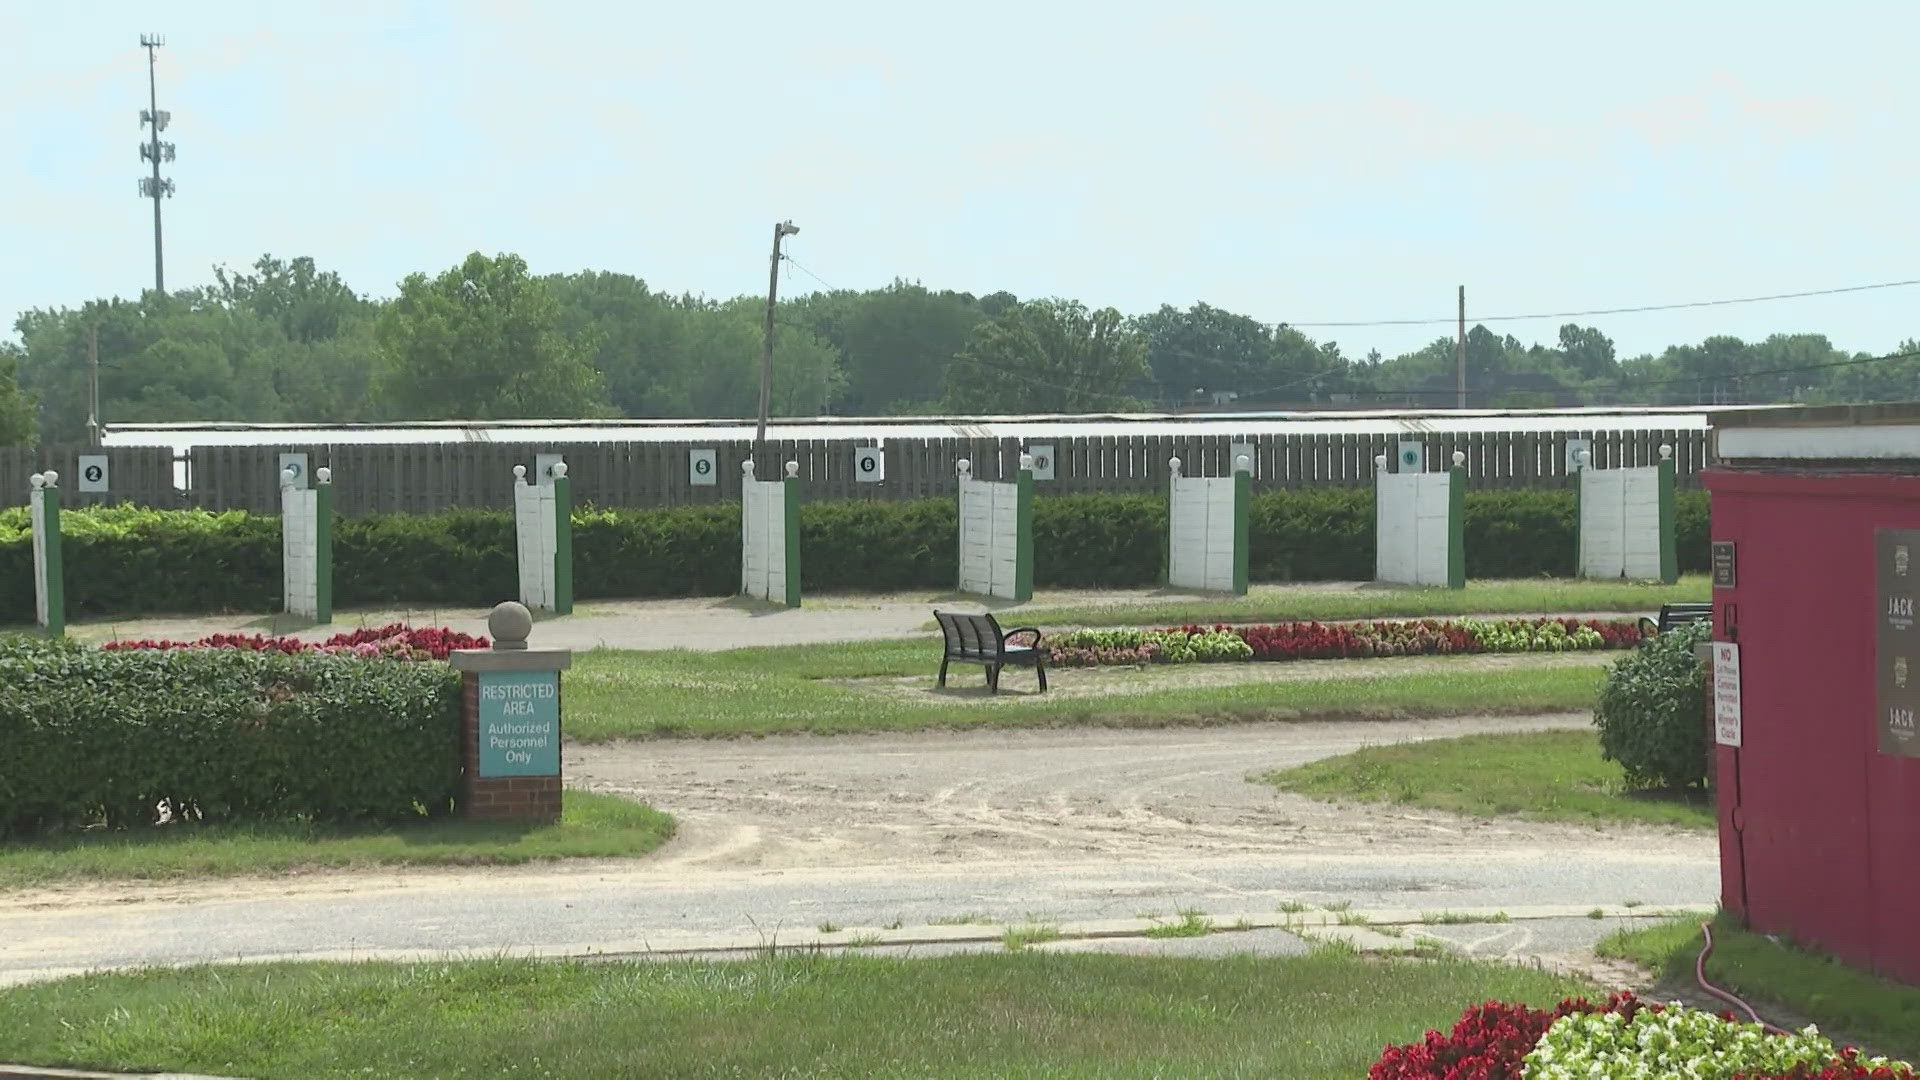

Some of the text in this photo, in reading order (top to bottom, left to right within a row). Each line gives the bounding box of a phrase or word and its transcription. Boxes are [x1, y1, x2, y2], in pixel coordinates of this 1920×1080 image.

[697, 460, 708, 474] 5
[863, 458, 874, 471] 6
[88, 466, 100, 481] 2
[1888, 597, 1914, 616] JACK
[1720, 647, 1731, 661] NO
[482, 683, 554, 700] RESTRICTED
[503, 701, 534, 716] AREA
[1889, 706, 1915, 728] JACK
[488, 722, 550, 735] Authorized
[490, 735, 548, 749] Personnel
[505, 750, 532, 765] Only
